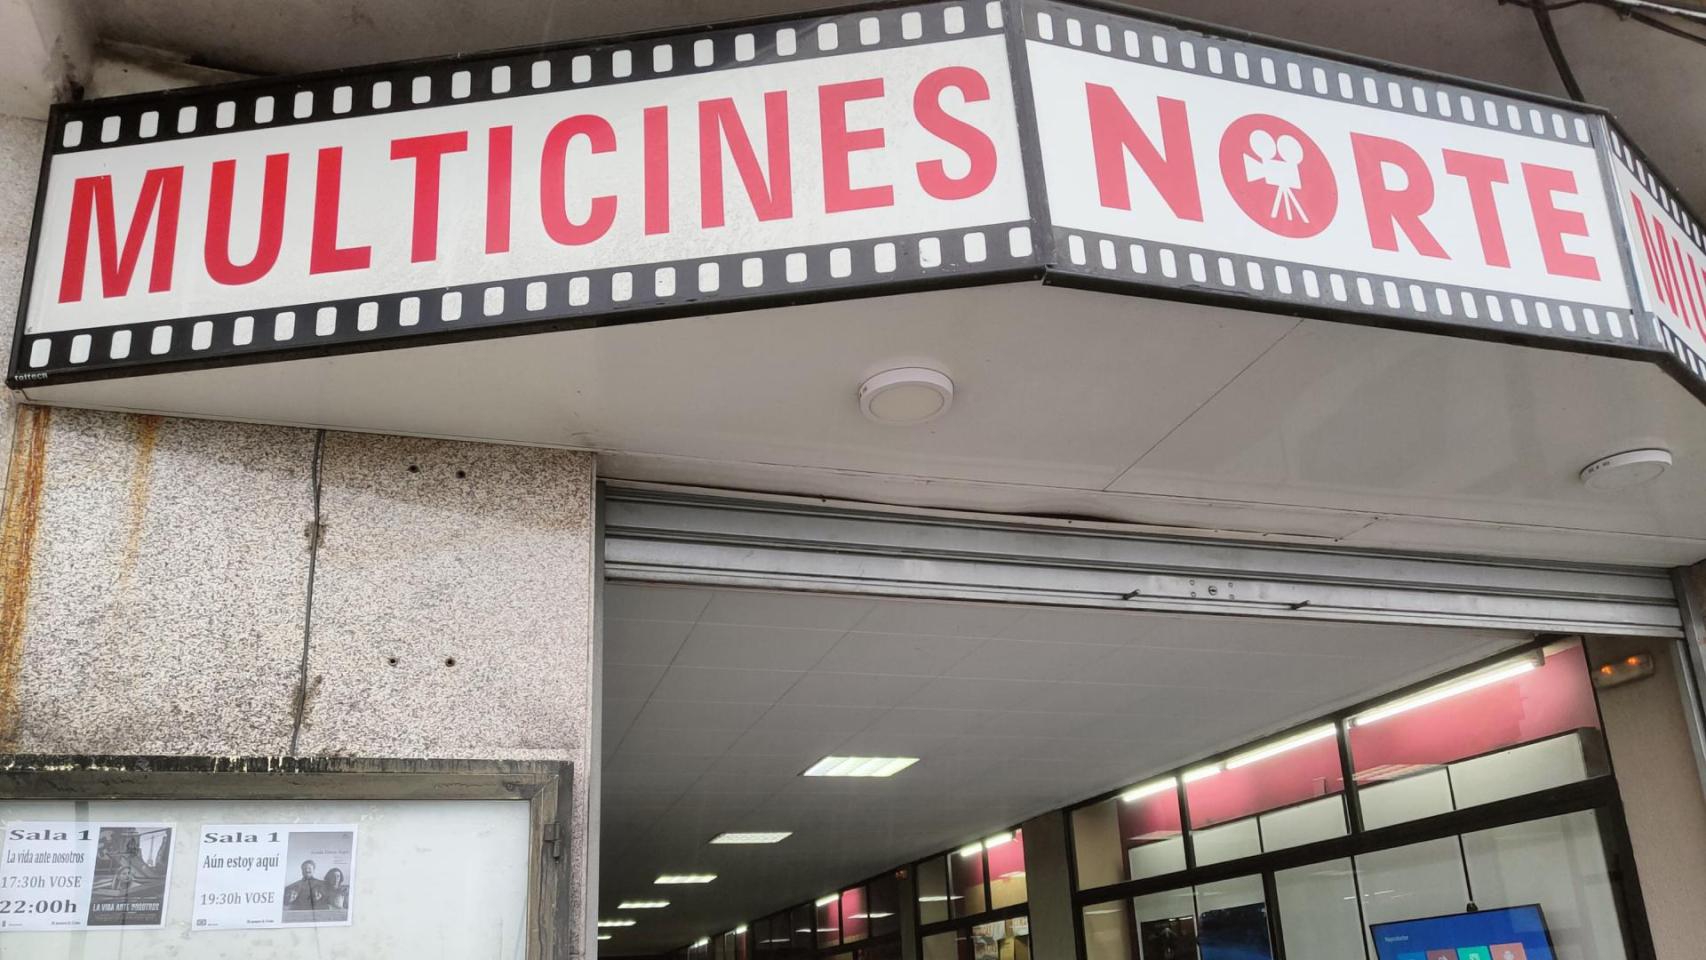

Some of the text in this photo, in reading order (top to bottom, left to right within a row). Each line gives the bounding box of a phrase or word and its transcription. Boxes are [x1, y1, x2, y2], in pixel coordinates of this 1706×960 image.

[58, 66, 1602, 304] MULTICINES NORTE
[9, 829, 92, 841] Sala 1
[203, 832, 280, 843] Sala 1
[7, 849, 85, 864] La vida ante nosotros
[203, 853, 280, 871] Aún estoy aquí
[1, 875, 82, 888] 17:30h VOSE
[200, 892, 275, 905] 19:30h VOSE
[0, 899, 77, 914] 22:00h
